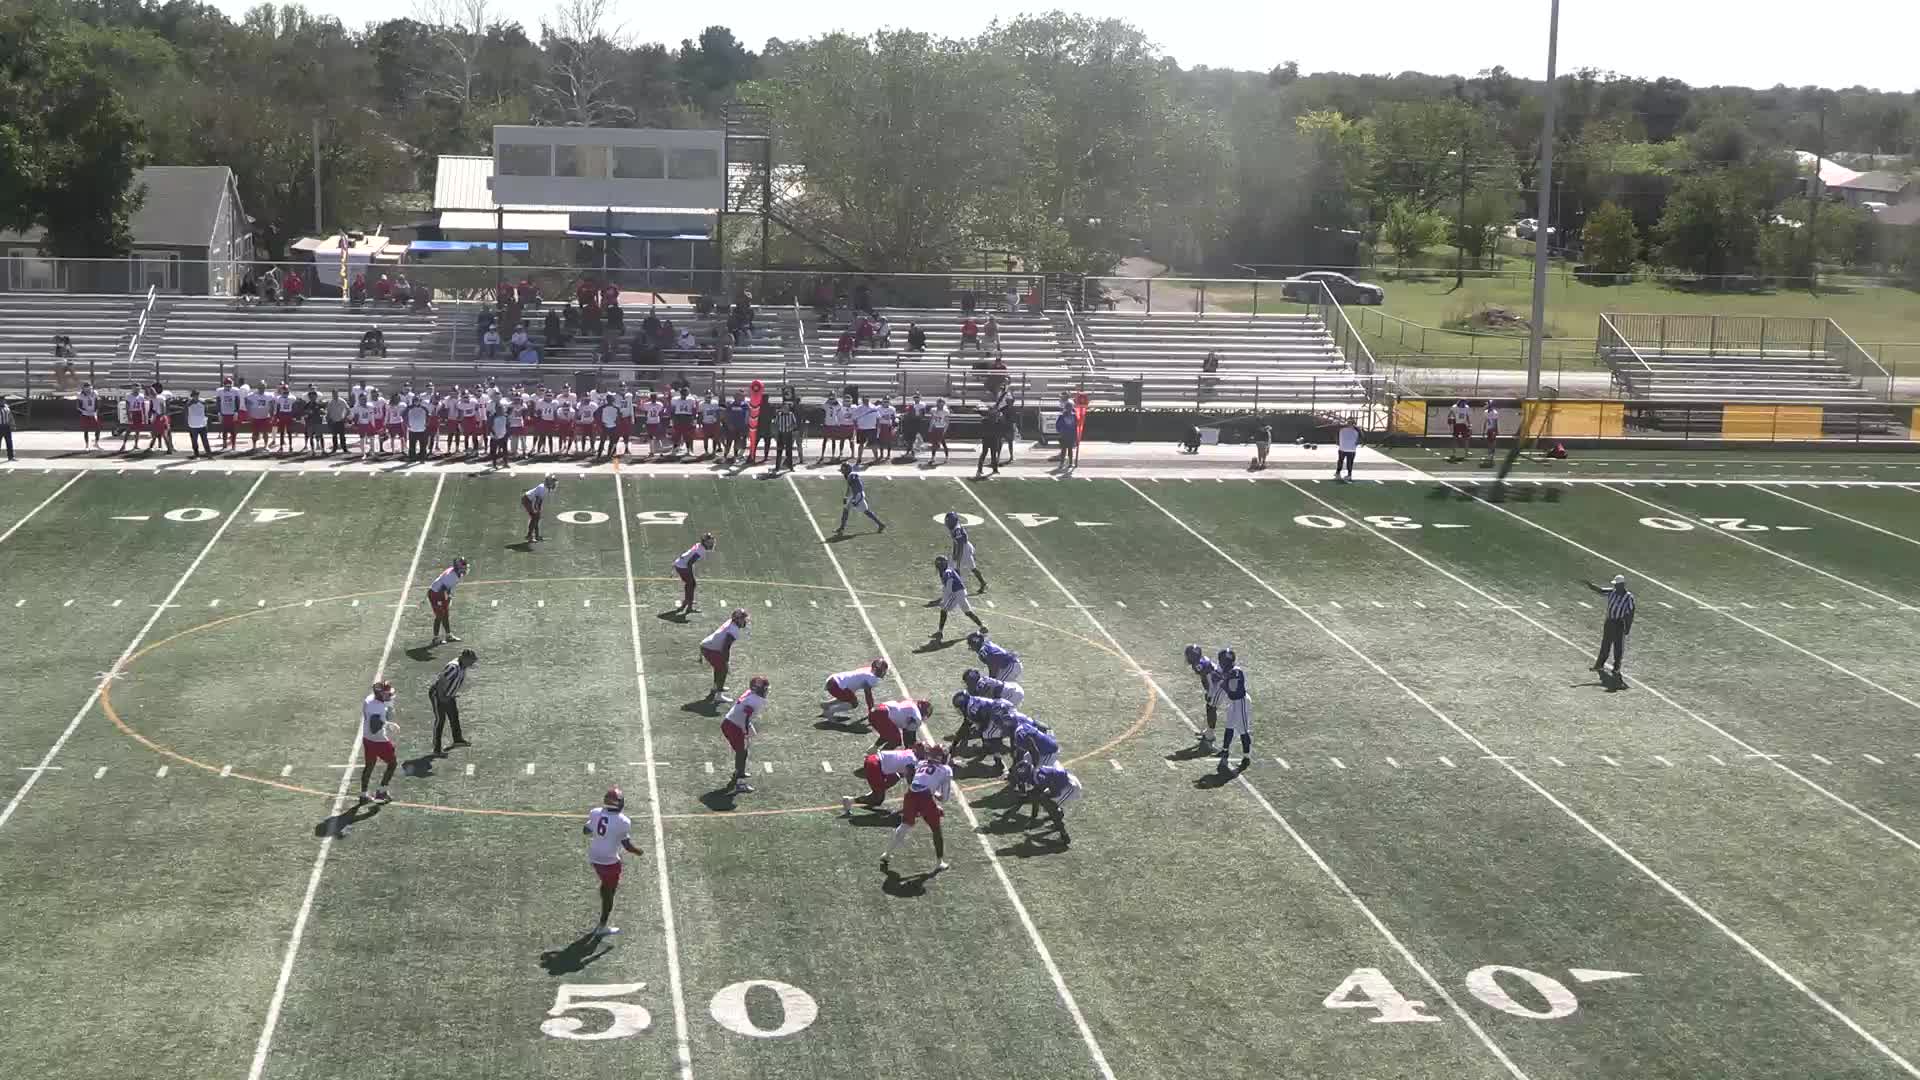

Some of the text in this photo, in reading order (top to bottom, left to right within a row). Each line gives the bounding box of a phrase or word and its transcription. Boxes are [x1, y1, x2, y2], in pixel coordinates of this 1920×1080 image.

[164, 507, 305, 522] 40
[556, 510, 689, 525] 50
[1293, 515, 1423, 529] 30
[1638, 517, 1770, 531] 20
[597, 816, 609, 837] 6
[1322, 965, 1579, 1022] 40
[540, 979, 819, 1040] 50
